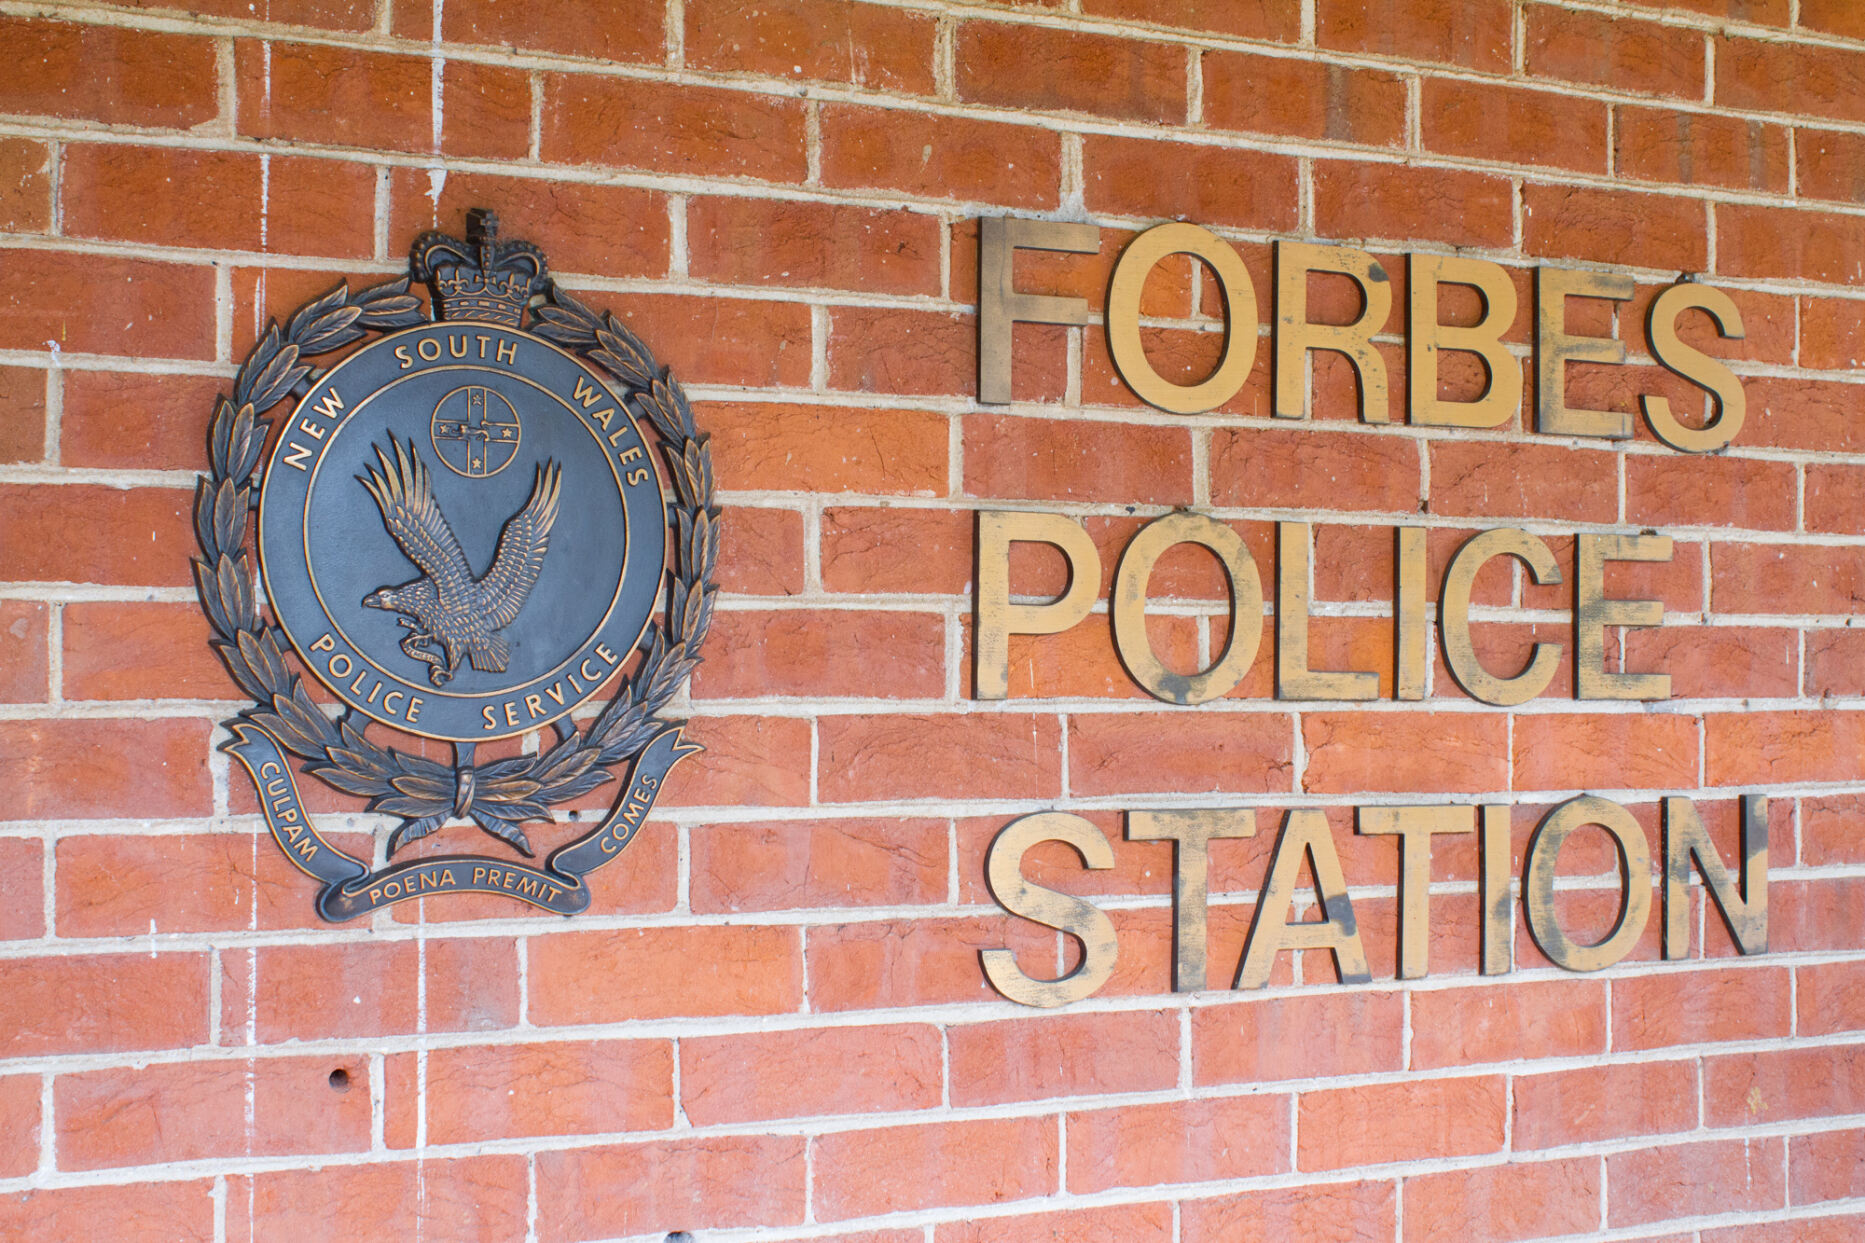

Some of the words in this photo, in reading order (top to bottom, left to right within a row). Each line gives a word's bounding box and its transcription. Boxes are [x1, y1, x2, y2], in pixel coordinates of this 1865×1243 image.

[284, 388, 345, 471] NEW
[395, 335, 519, 369] SOUTH
[572, 376, 649, 488] WALES
[976, 216, 1747, 453] FORBES
[309, 633, 423, 723] POLICE
[482, 643, 619, 730] SERVICE
[972, 510, 1674, 706] POLICE
[260, 761, 319, 863] CULPAM
[368, 868, 457, 904] POENA
[472, 867, 562, 904] PREMIT
[599, 773, 658, 854] COMES
[977, 793, 1769, 1008] STATION
